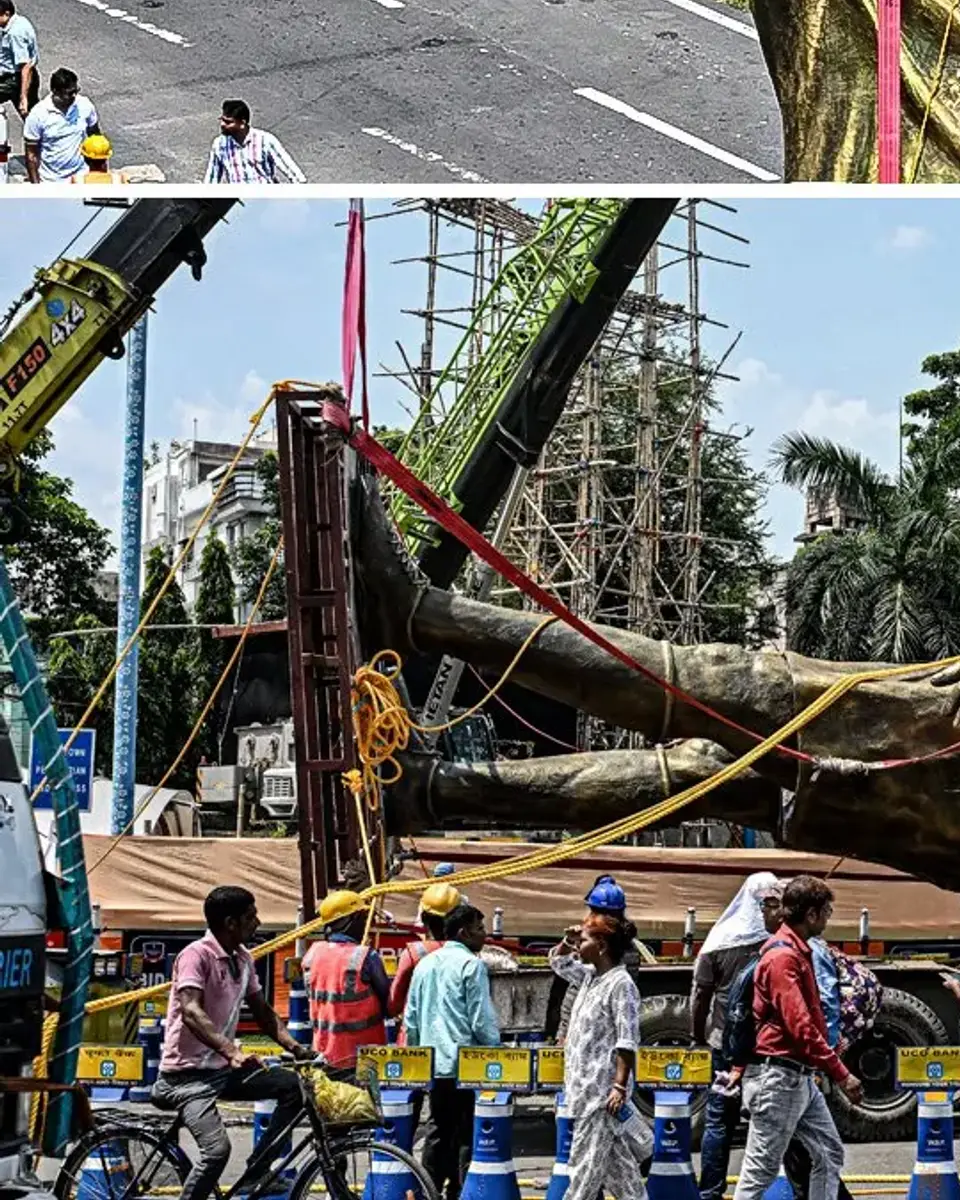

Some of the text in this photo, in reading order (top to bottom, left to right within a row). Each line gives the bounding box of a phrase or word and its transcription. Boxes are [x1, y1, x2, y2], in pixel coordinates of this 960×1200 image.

[7, 344, 46, 393] F150
[360, 1049, 428, 1057] UCO BANK
[901, 1049, 928, 1057] UCO
